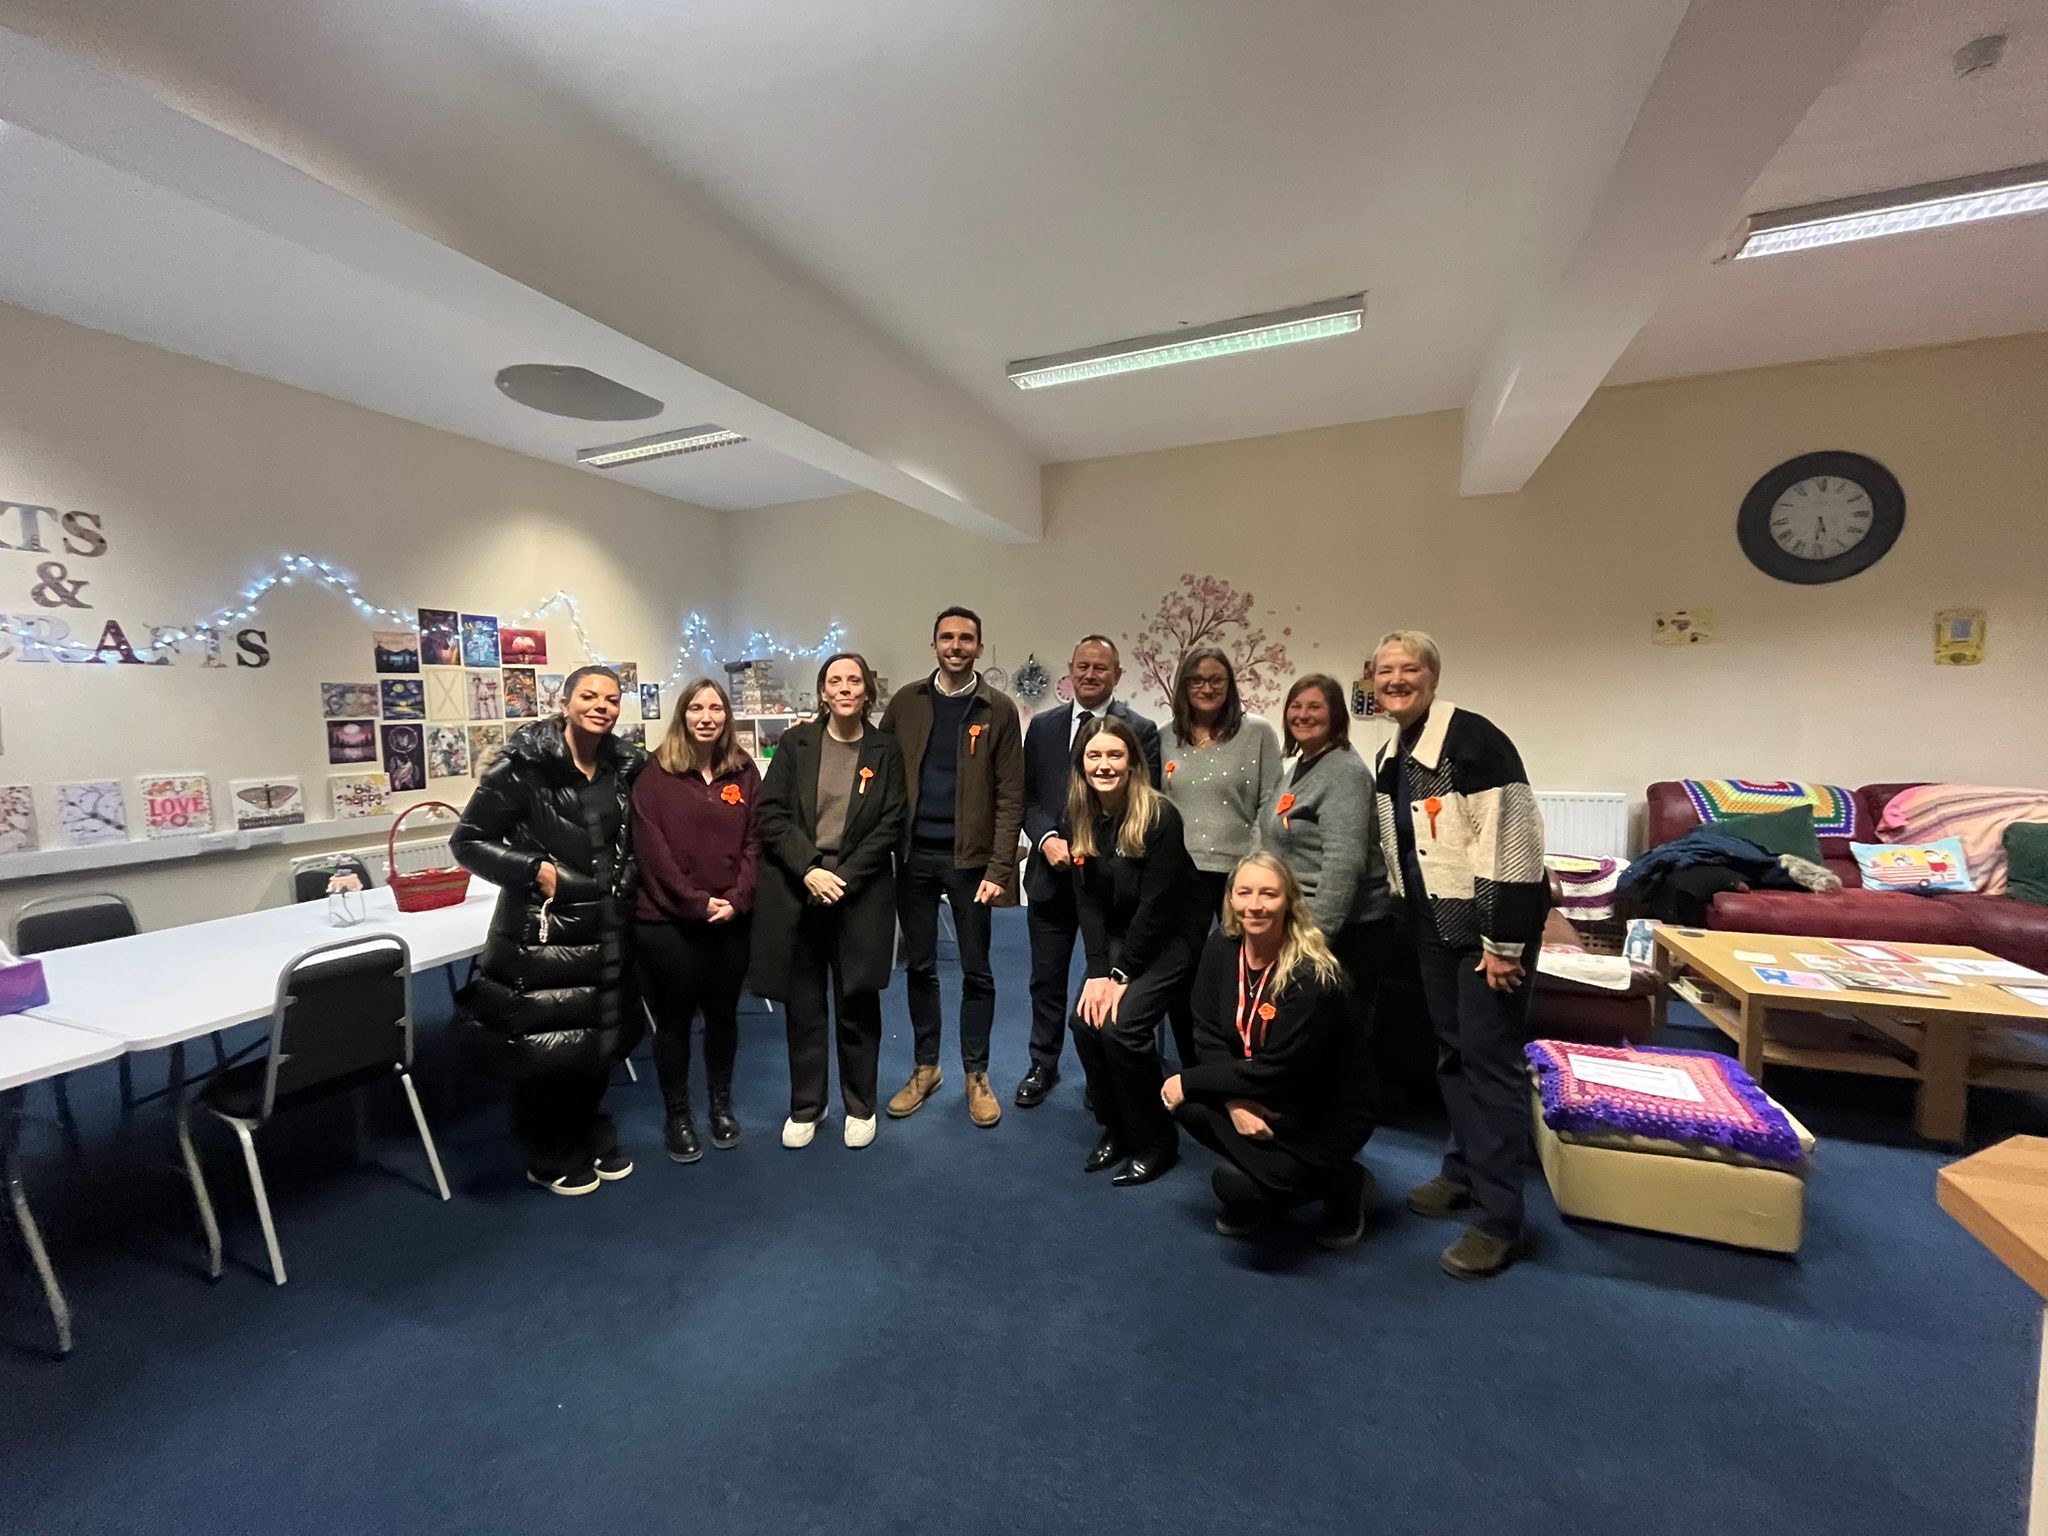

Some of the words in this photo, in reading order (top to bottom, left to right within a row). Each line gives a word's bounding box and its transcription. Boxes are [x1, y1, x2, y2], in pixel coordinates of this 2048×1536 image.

[0, 501, 108, 558] TS
[31, 561, 94, 609] &
[149, 797, 207, 817] LOVE
